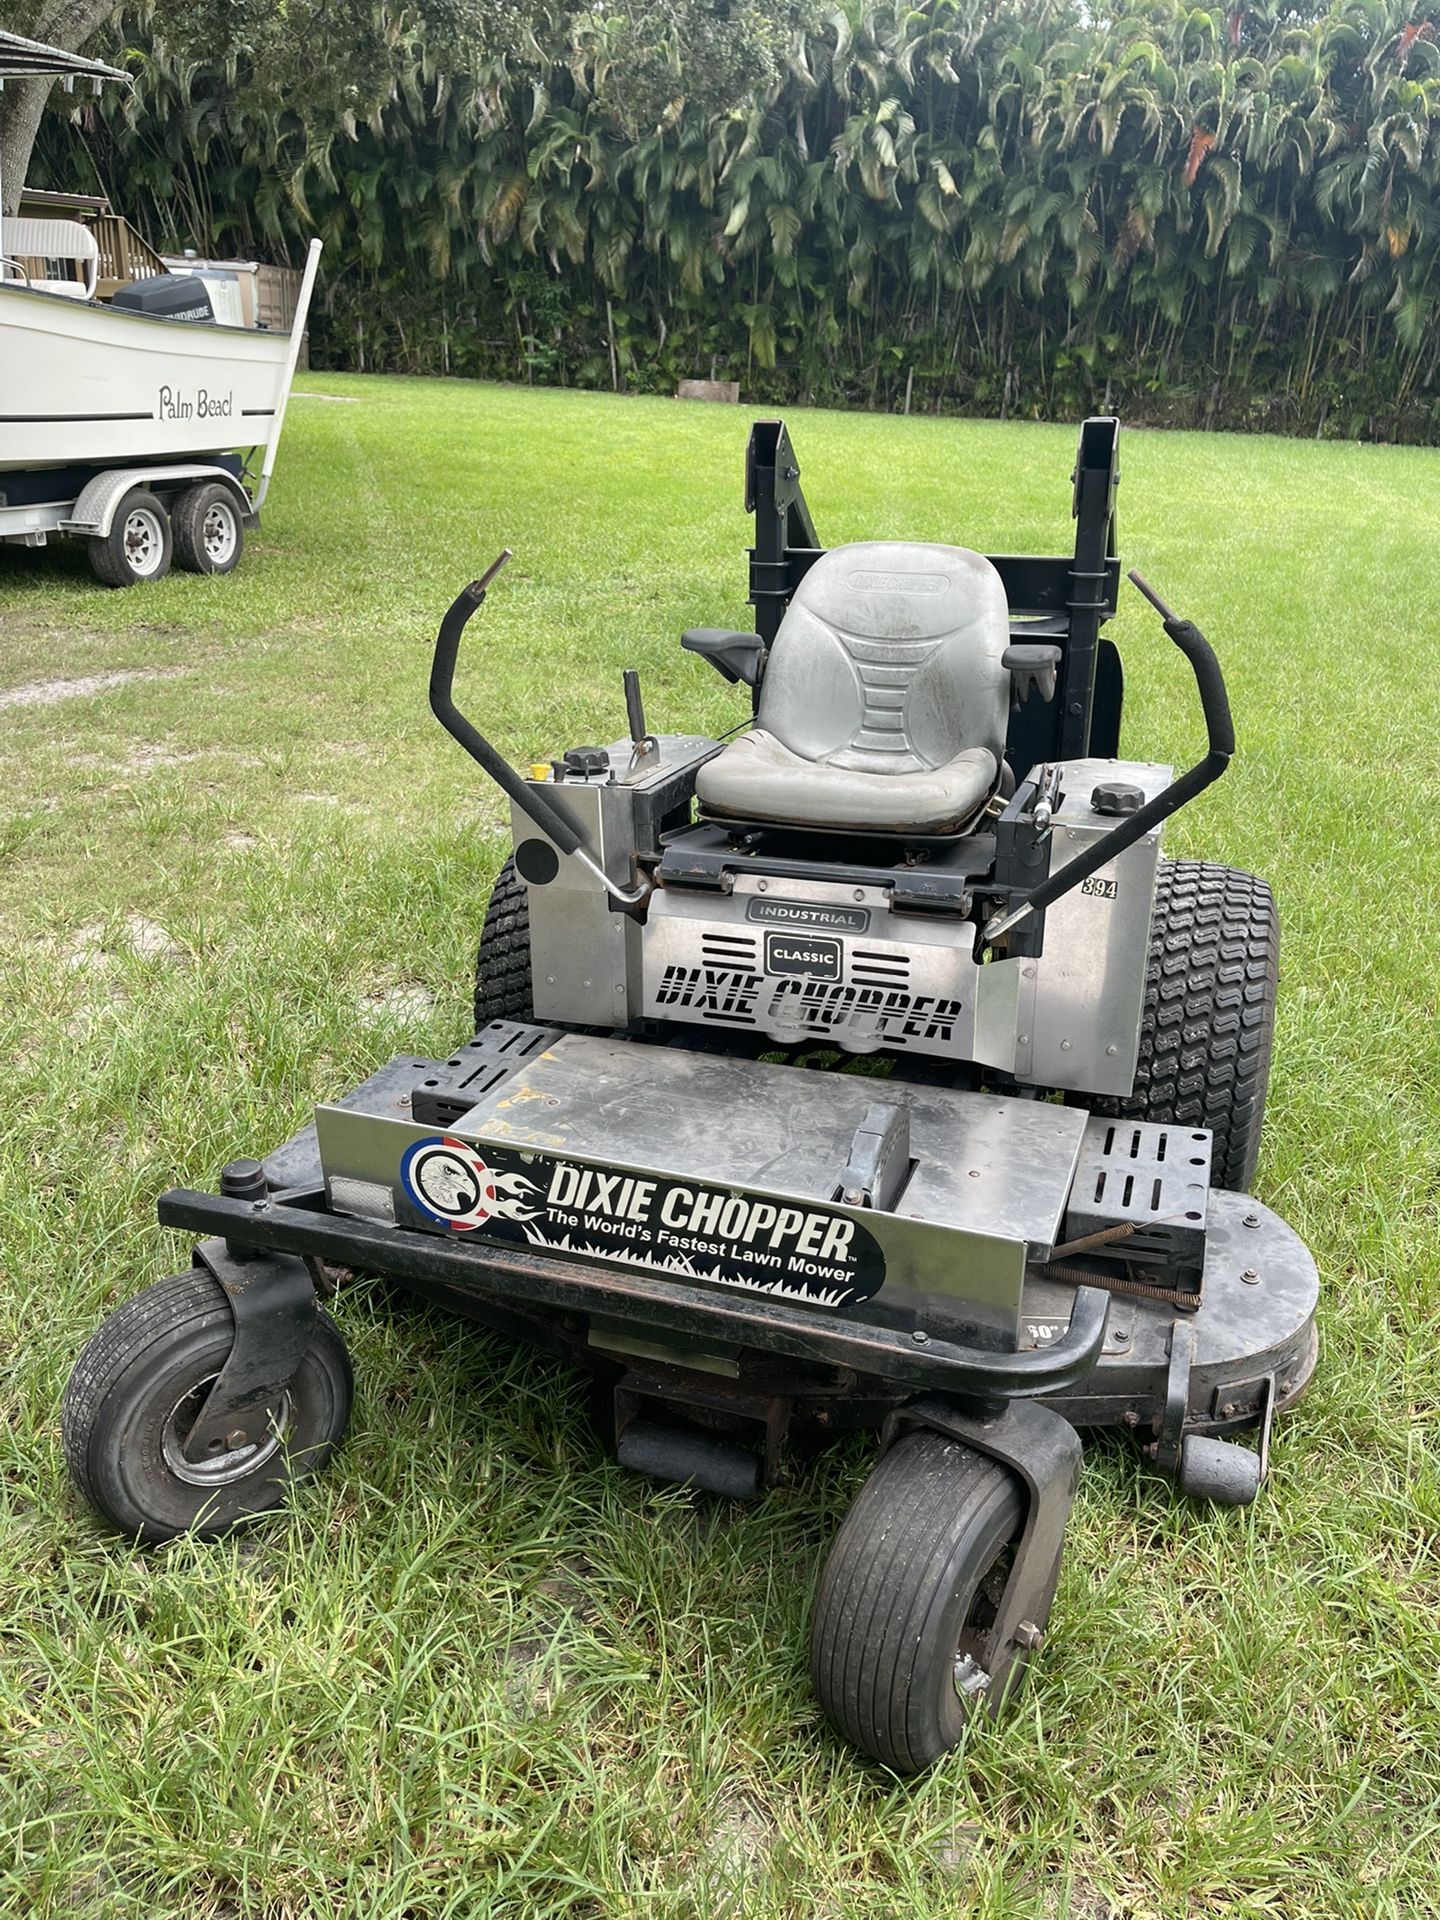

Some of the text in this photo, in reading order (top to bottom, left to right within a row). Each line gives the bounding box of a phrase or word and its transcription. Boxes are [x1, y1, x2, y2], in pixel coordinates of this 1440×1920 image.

[159, 385, 193, 422] Palm
[1083, 877, 1117, 898] 394
[760, 906, 856, 925] INDUSTRIAL
[773, 949, 834, 964] CLASSIC
[656, 966, 962, 1040] DIXIE CHOPPER
[547, 1165, 657, 1222] DIXIE
[660, 1187, 855, 1262] CHOPPER
[546, 1208, 855, 1283] The World's Fastest Lawn Mower
